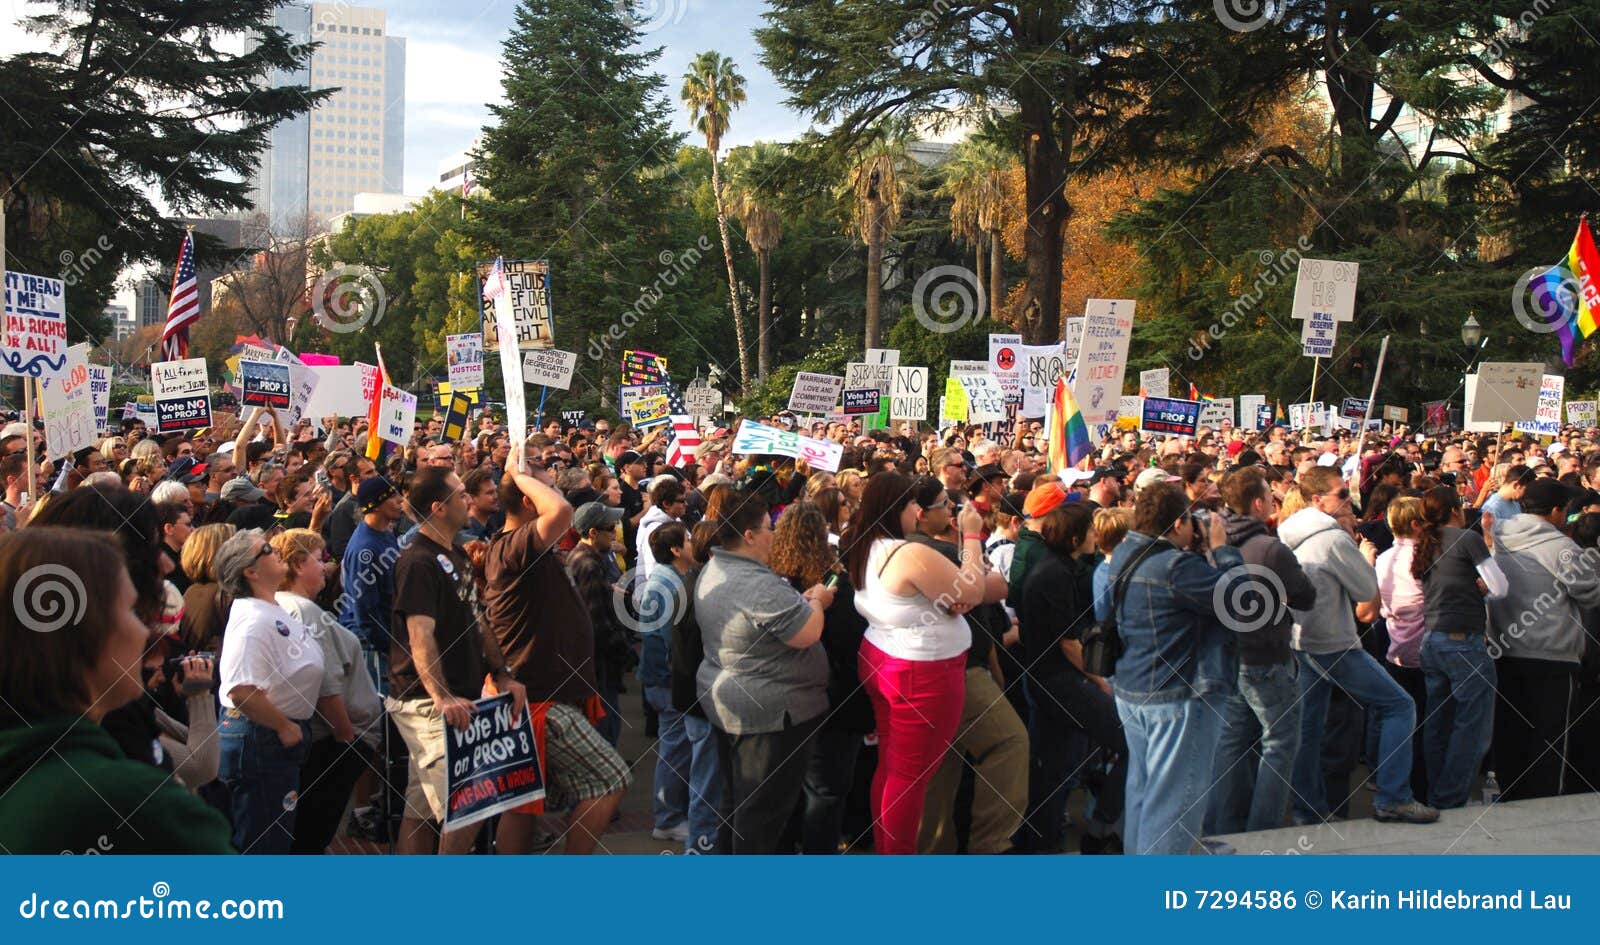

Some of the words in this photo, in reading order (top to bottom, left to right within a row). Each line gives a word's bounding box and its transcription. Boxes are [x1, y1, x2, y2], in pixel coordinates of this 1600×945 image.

[503, 261, 524, 273] NO
[1300, 260, 1322, 281] NO
[1334, 262, 1357, 283] ON
[22, 275, 61, 297] TREAD
[1312, 281, 1336, 307] H8
[513, 308, 549, 321] CIVIL
[1313, 312, 1322, 321] WE
[1323, 313, 1332, 321] ALL
[28, 317, 66, 339] RIGHTS
[1309, 321, 1334, 330] DESERVE
[1315, 329, 1326, 337] THE
[26, 336, 56, 354] ALL!
[1306, 337, 1332, 346] FREEDOM
[1305, 346, 1312, 354] TO
[1313, 346, 1332, 355] MARRY
[1088, 352, 1117, 362] PROTECT
[452, 365, 481, 374] JUSTICE
[525, 359, 569, 374] SEGREGATED
[800, 374, 833, 385] MARRIAGE
[897, 369, 922, 393] NO
[91, 381, 107, 392] ERVE
[260, 381, 281, 392] PROP
[282, 384, 288, 393] 8
[687, 395, 712, 404] LIFE
[795, 393, 836, 402] COMMITMENT
[847, 392, 864, 400] Vote
[866, 391, 878, 399] NO
[1540, 390, 1560, 399] WHERE
[160, 403, 185, 412] Vote
[187, 400, 206, 410] NO
[893, 397, 908, 416] ON
[909, 397, 924, 417] H8
[1568, 403, 1588, 413] PROP
[175, 410, 198, 418] PROP
[395, 410, 402, 421] IS
[562, 410, 584, 420] WTF
[634, 409, 652, 420] Yes
[1160, 412, 1186, 423] PROP
[1187, 415, 1194, 424] 8
[390, 424, 404, 437] NOT
[997, 419, 1016, 432] MY
[453, 719, 491, 748] Vote
[454, 755, 470, 777] on
[473, 735, 516, 769] PROP
[520, 732, 529, 754] 8
[452, 778, 497, 810] UNFAIR
[507, 766, 535, 791] WRONG
